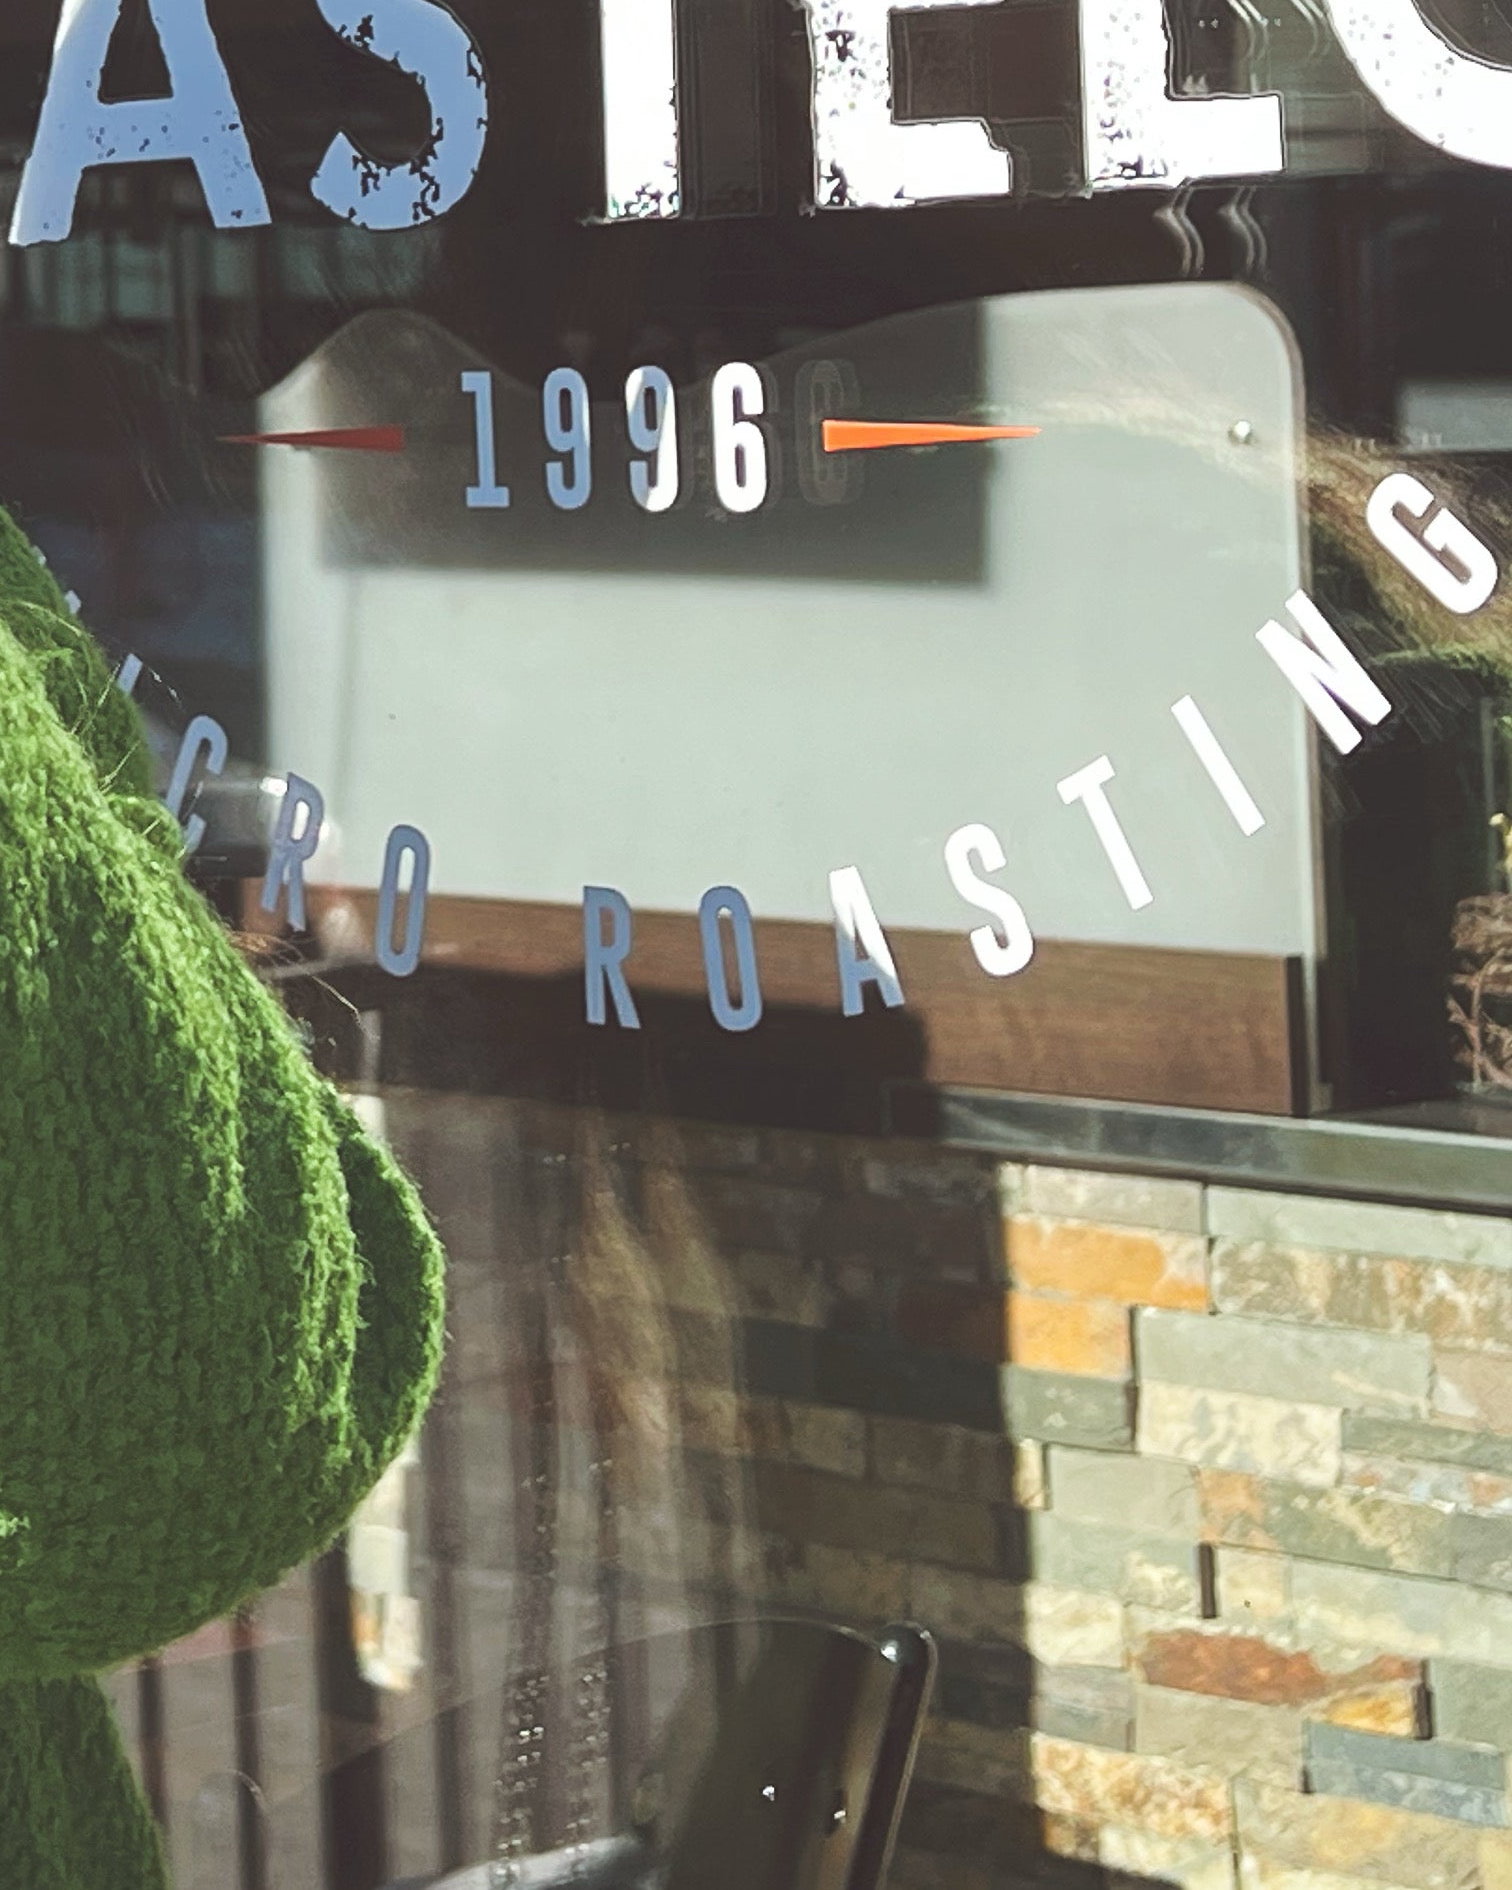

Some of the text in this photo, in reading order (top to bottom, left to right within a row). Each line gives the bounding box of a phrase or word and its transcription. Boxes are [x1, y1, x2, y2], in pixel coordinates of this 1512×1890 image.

[462, 361, 769, 514] 1996
[33, 472, 1499, 1034] CRO ROASTING
